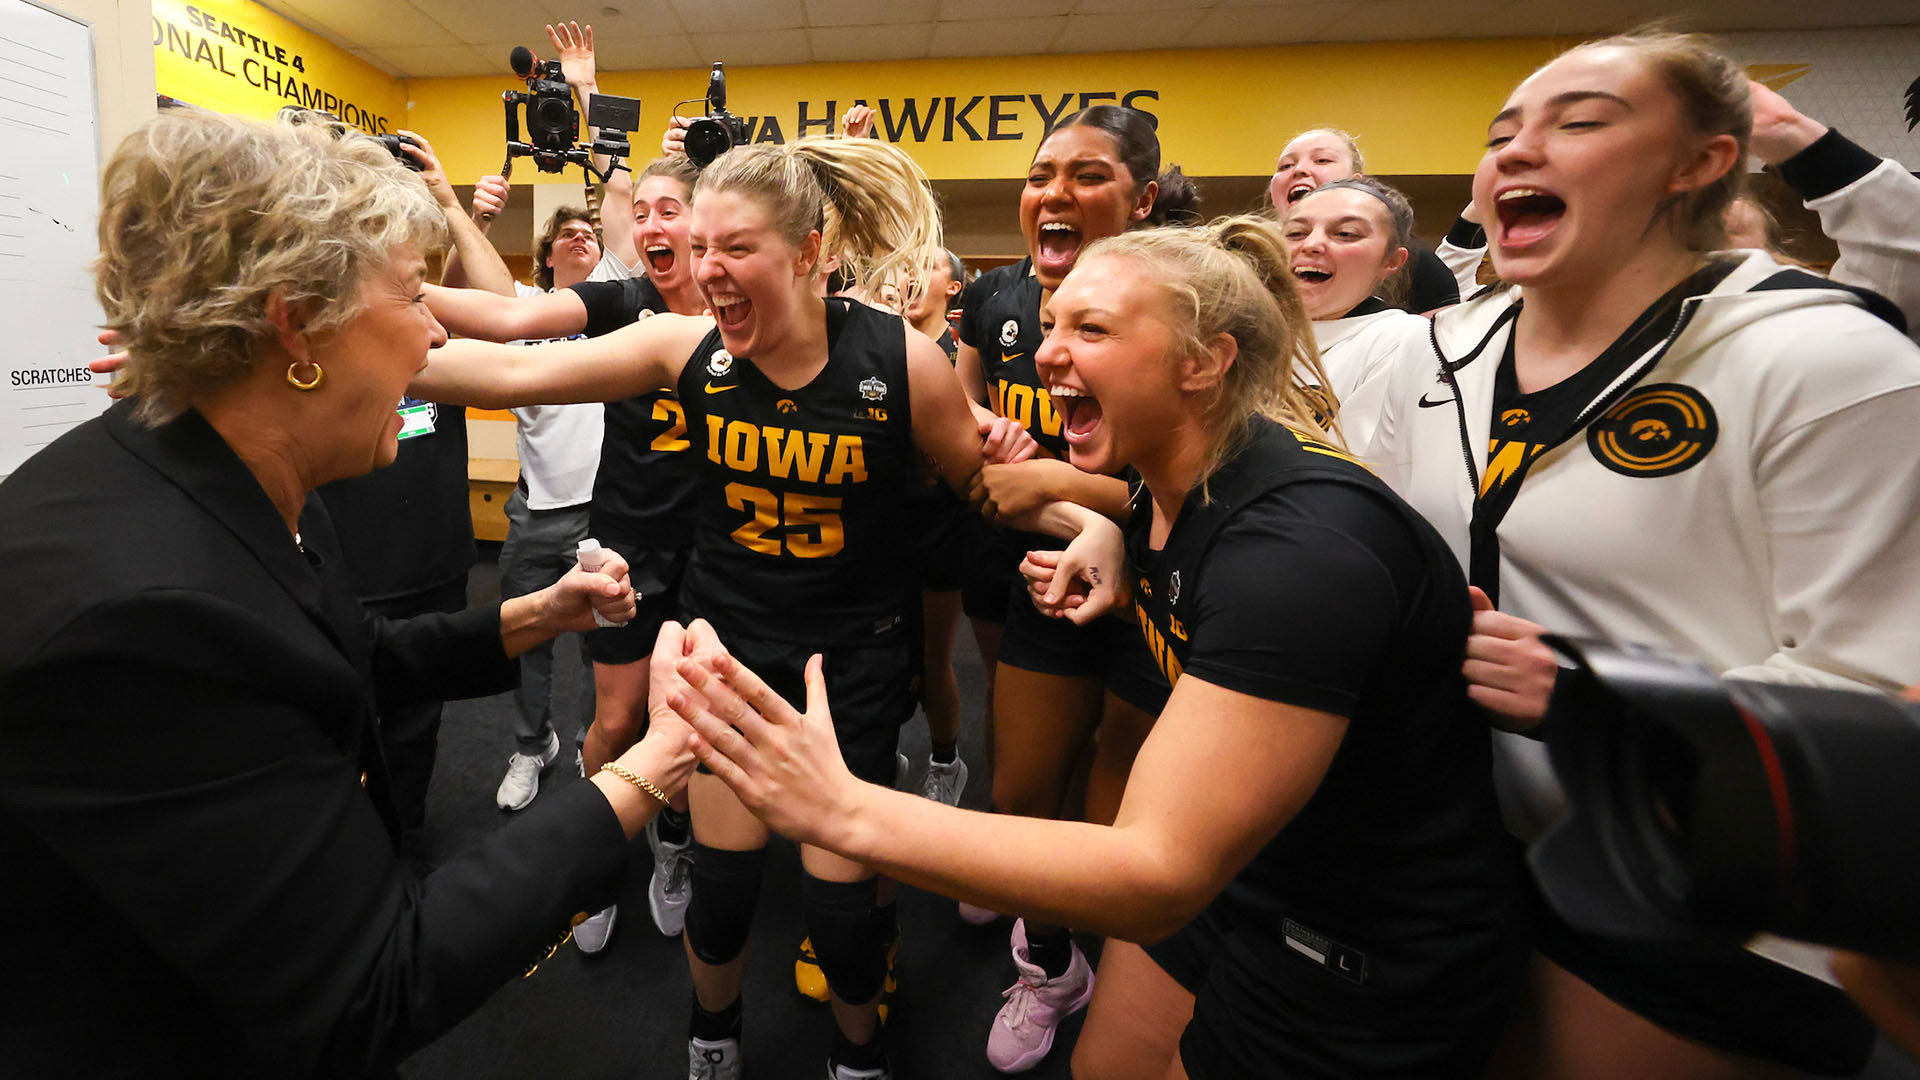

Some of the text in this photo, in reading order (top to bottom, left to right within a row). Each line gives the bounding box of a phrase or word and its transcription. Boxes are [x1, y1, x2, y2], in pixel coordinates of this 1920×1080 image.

[186, 5, 305, 74] SEATTLE 4
[243, 58, 389, 136] CHAMPIONS
[11, 367, 92, 386] SCRATCHES
[650, 399, 691, 452] 2
[705, 414, 868, 485] IOWA
[724, 481, 845, 559] 25
